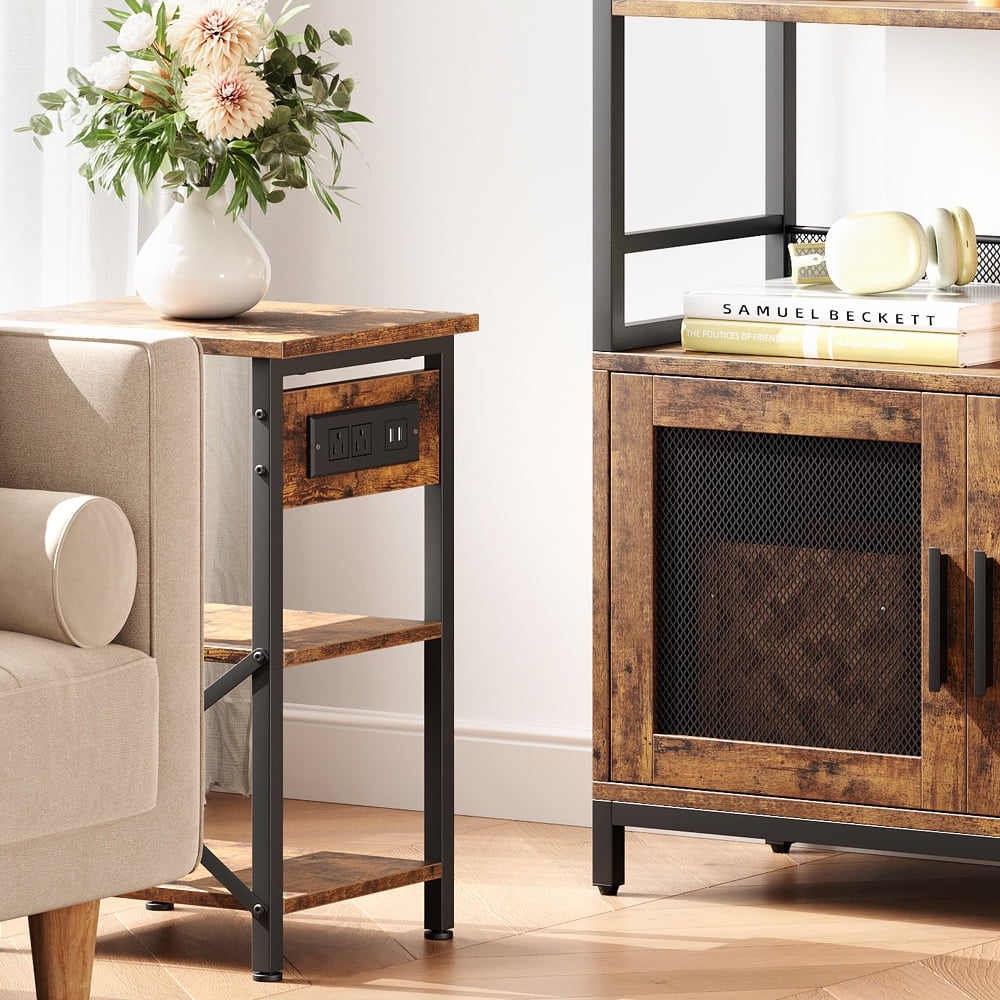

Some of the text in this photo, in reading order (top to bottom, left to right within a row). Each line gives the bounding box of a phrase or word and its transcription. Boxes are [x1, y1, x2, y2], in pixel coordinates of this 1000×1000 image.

[722, 303, 936, 327] SAMUEL BECKETT
[686, 329, 701, 338] THE
[741, 332, 752, 341] OF
